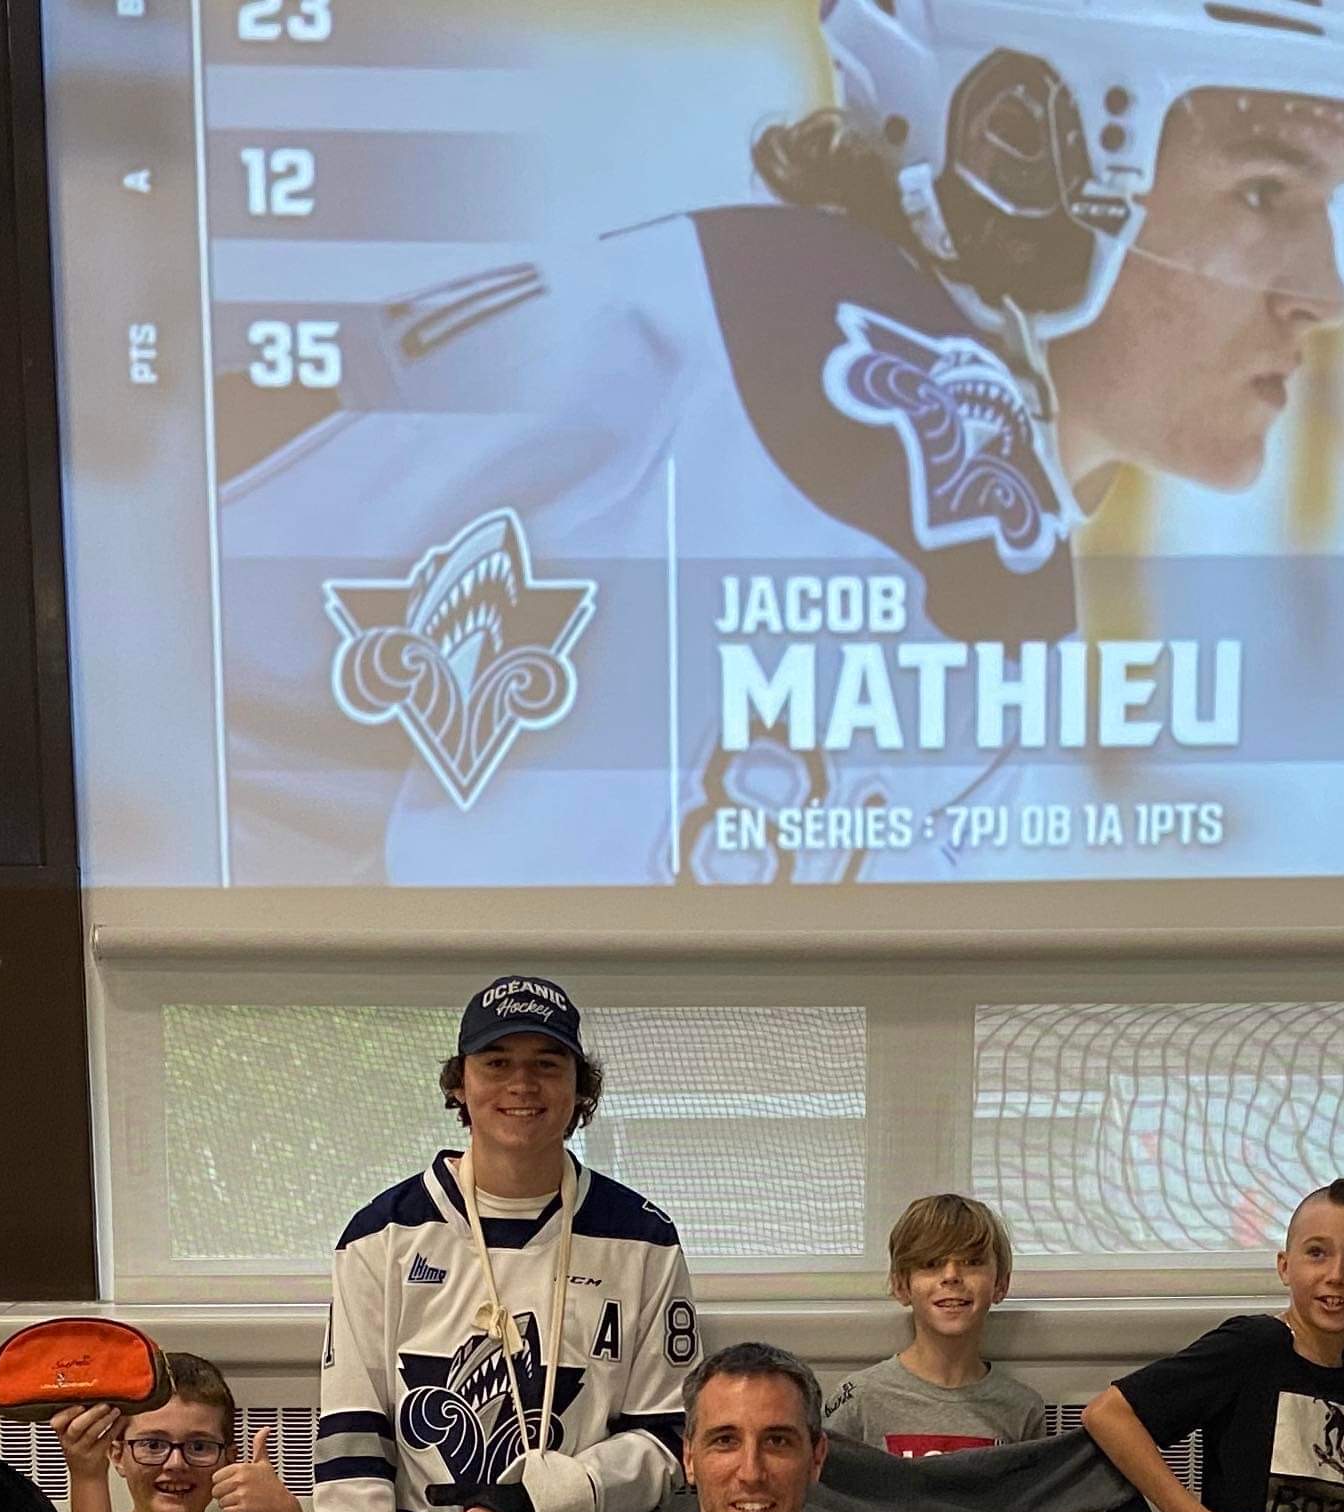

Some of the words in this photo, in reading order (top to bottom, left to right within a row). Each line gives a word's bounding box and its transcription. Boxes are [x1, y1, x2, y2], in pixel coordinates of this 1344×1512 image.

[237, 0, 333, 41] 23
[122, 168, 152, 193] A
[240, 148, 316, 216] 12
[128, 323, 158, 384] PTS
[248, 321, 342, 388] 35
[716, 577, 907, 635] JACOB
[718, 640, 1242, 751] MATHIEU
[716, 808, 766, 851] EN
[946, 806, 1009, 848] 7PJ
[1084, 805, 1124, 845] 1A
[1136, 803, 1224, 845] 1PTS
[496, 999, 555, 1023] Hockey
[590, 1299, 623, 1363] A
[663, 1299, 699, 1368] 8
